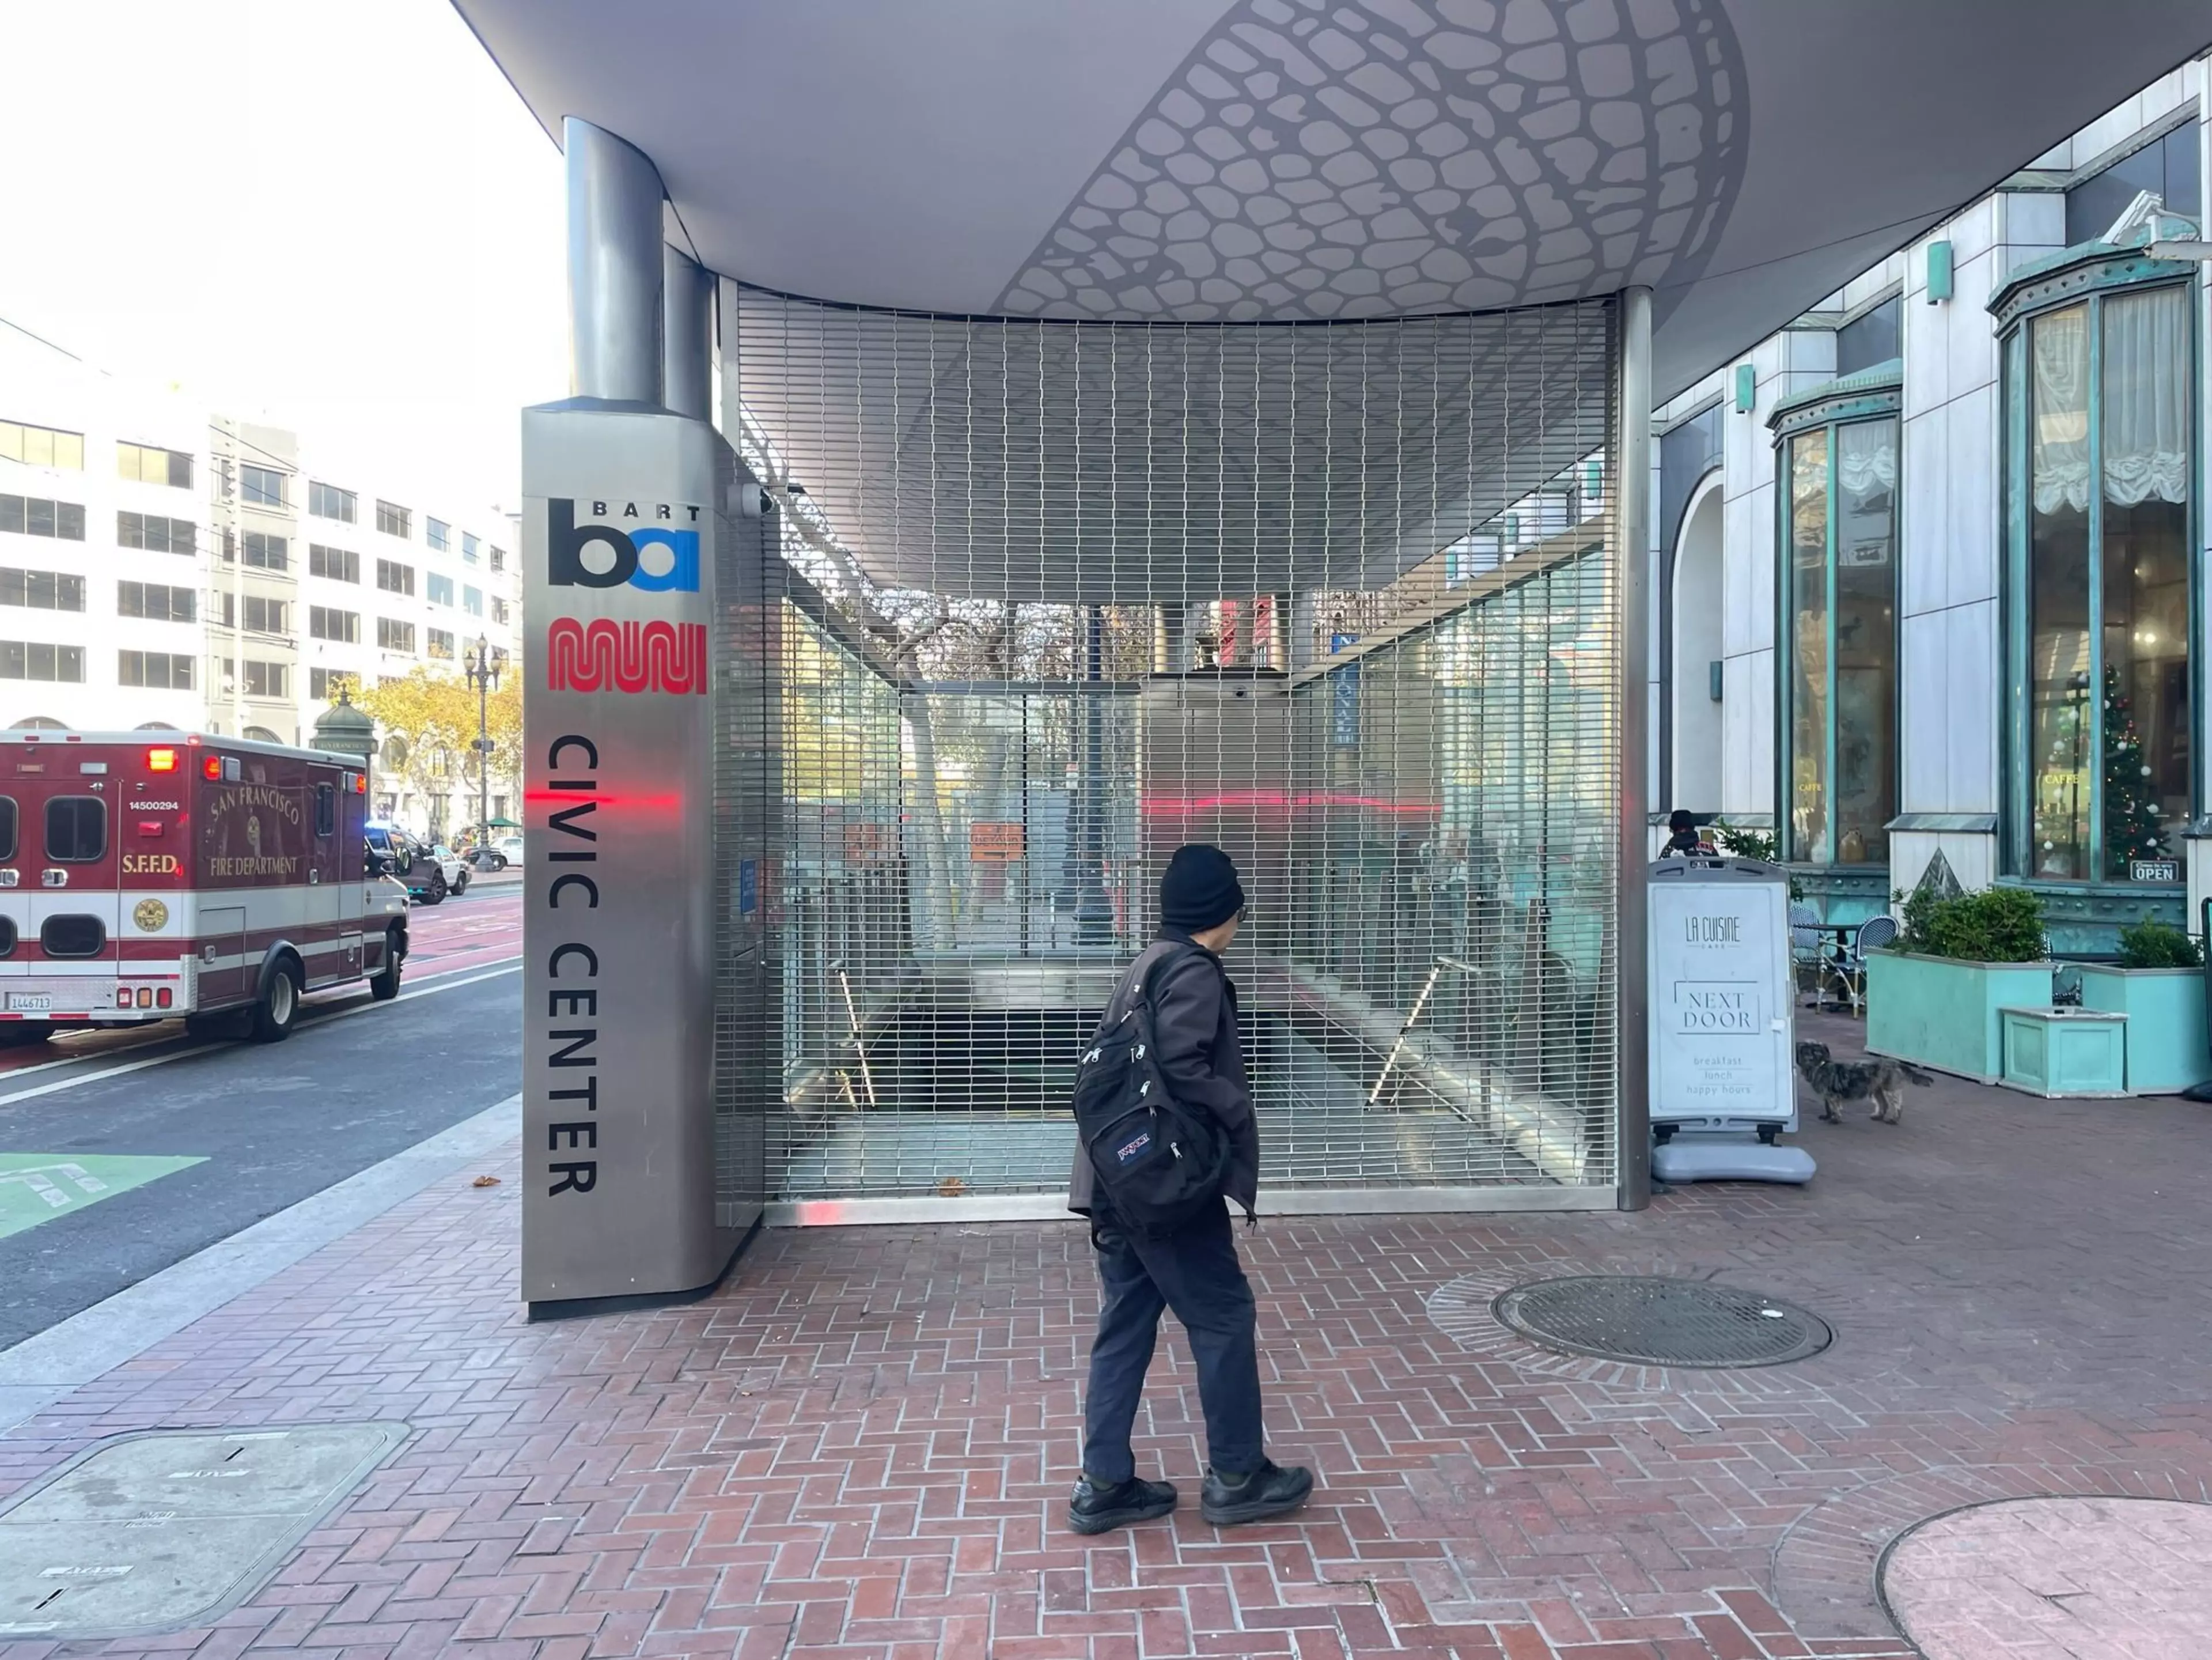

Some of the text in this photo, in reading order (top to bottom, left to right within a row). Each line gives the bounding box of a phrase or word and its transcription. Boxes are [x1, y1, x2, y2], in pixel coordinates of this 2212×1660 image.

[593, 501, 700, 521] BART
[129, 801, 179, 810] 14500294
[211, 785, 299, 825] SAN FRANCISCO
[211, 857, 297, 876] FIRE DEPARTMENT
[2136, 868, 2173, 880] OPEN
[1685, 916, 1740, 942] LA CUISINE
[549, 735, 599, 1197] CIVIC CENTER
[1689, 992, 1744, 1008] NEXT
[1684, 1011, 1751, 1027] DOOR
[1694, 1056, 1741, 1066] breakfast
[1705, 1071, 1733, 1080] lunch
[1687, 1084, 1751, 1096] happy hours
